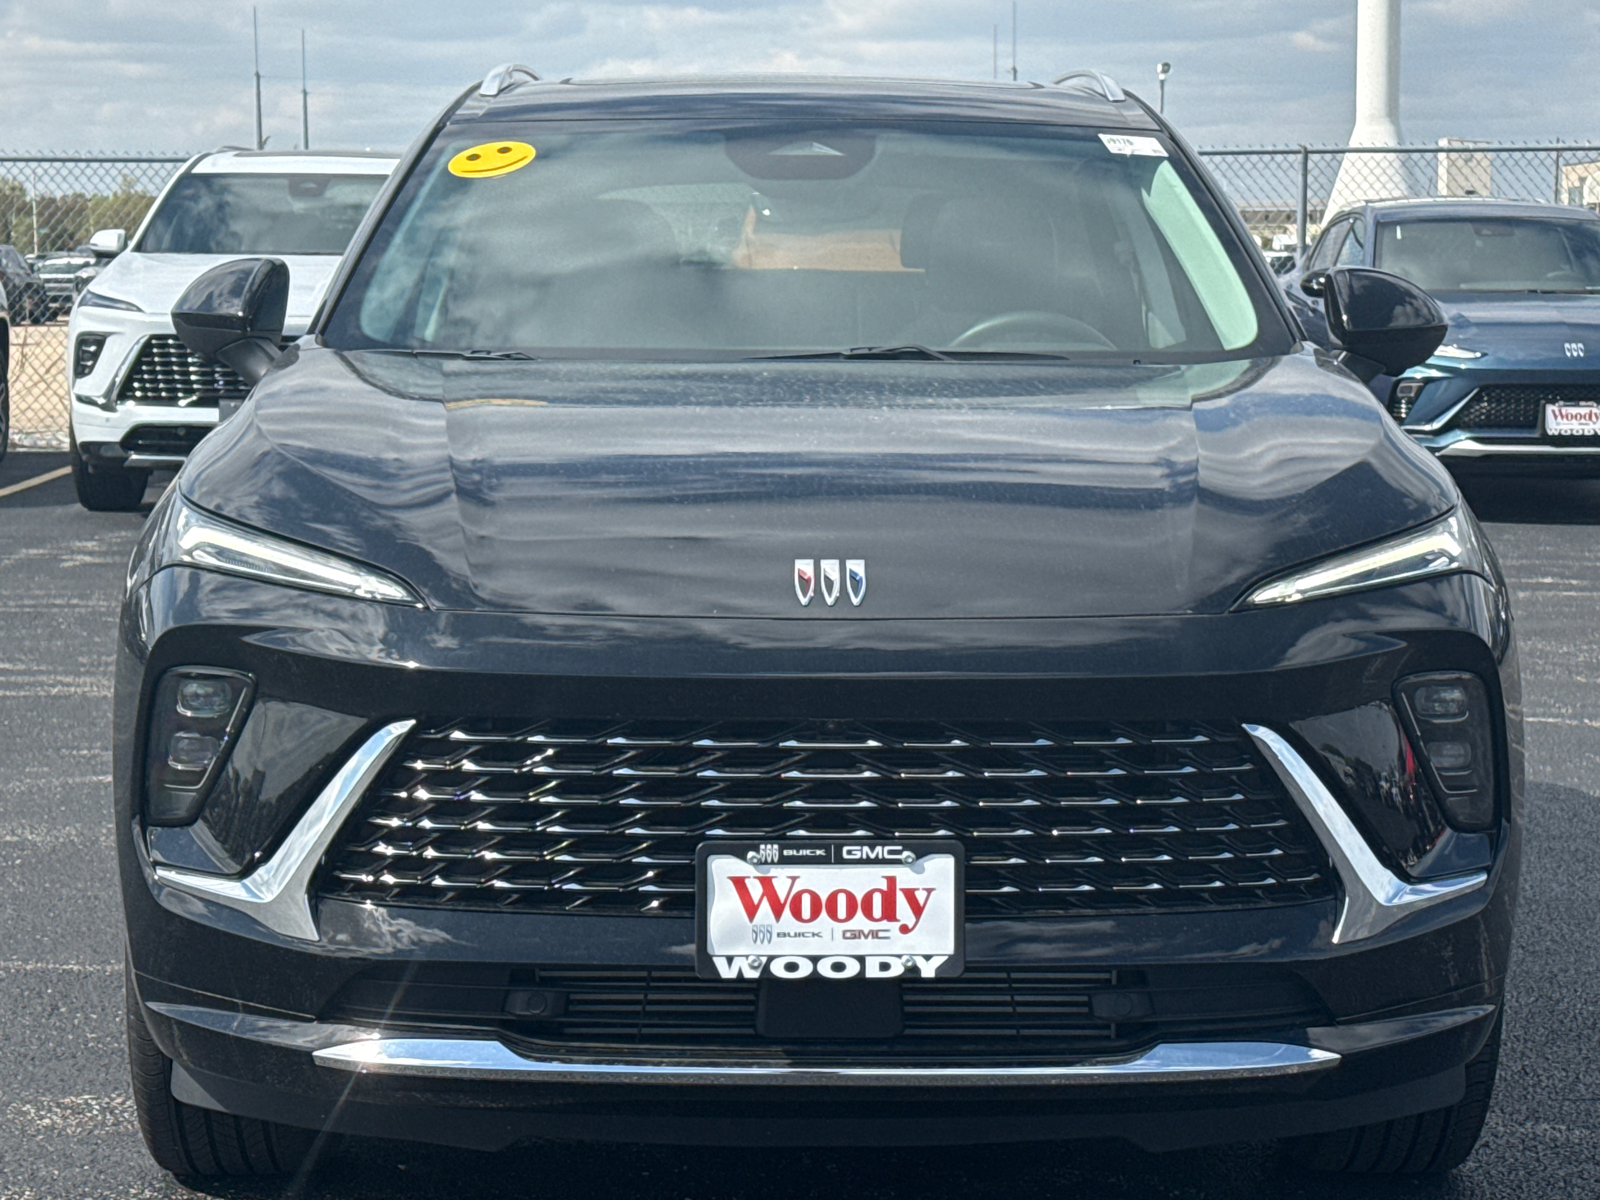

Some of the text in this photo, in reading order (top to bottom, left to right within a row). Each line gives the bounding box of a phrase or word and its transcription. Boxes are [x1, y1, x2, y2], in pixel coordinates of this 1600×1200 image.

[1551, 409, 1600, 425] Woody
[783, 845, 903, 860] BUICK GMC
[727, 875, 936, 935] Woody
[841, 929, 891, 940] GMC
[711, 955, 949, 979] WOODY
